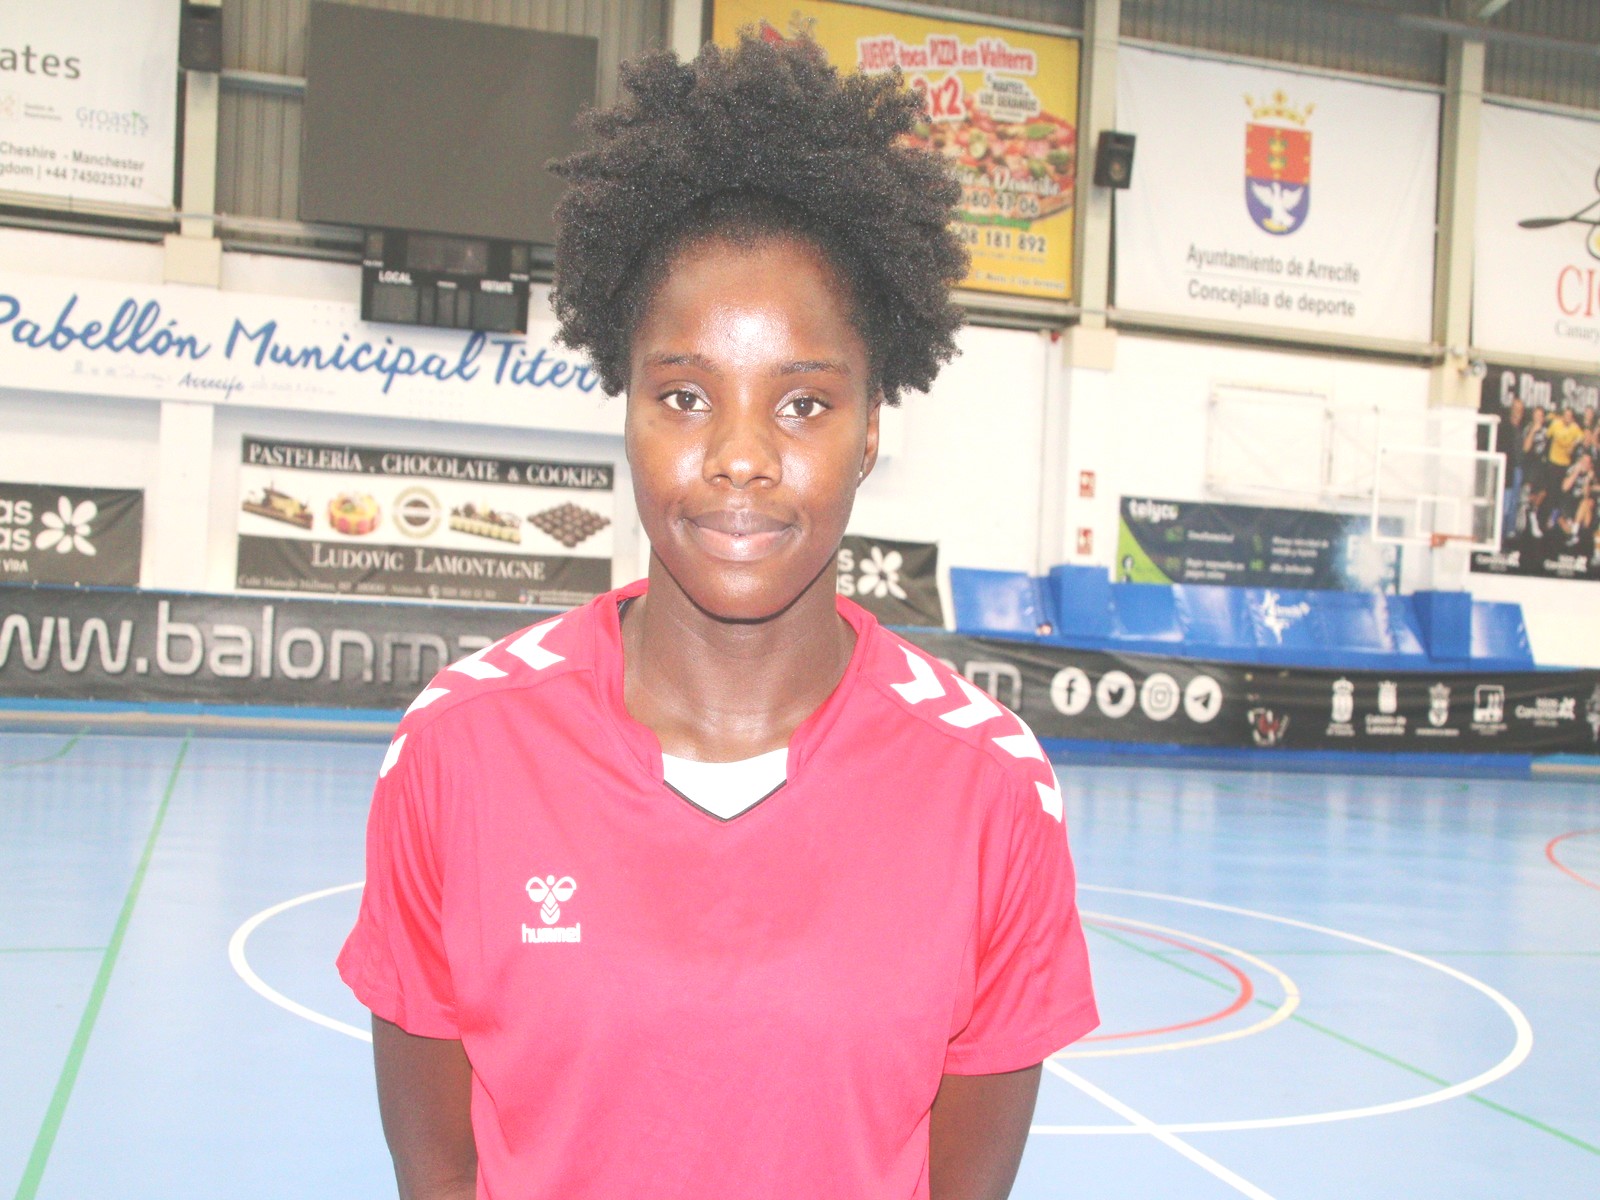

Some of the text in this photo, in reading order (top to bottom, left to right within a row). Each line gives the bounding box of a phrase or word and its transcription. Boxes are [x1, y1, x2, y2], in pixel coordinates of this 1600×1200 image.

[0, 44, 81, 80] ates
[0, 140, 57, 160] Cheshire
[72, 148, 145, 172] Manchester
[985, 228, 1012, 249] 181
[1017, 232, 1047, 254] 892
[378, 270, 413, 286] LOCAL
[1186, 241, 1361, 285] Ayuntamiento de Arrecife
[1274, 290, 1293, 311] de
[1297, 293, 1357, 319] deporte
[1555, 263, 1600, 318] CI
[225, 317, 481, 395] Municipal
[249, 442, 363, 472] PASTELERÍA
[381, 453, 499, 481] CHOCOLATE
[507, 465, 520, 483] &
[526, 463, 609, 487] COOKIES
[521, 921, 581, 943] hummel
